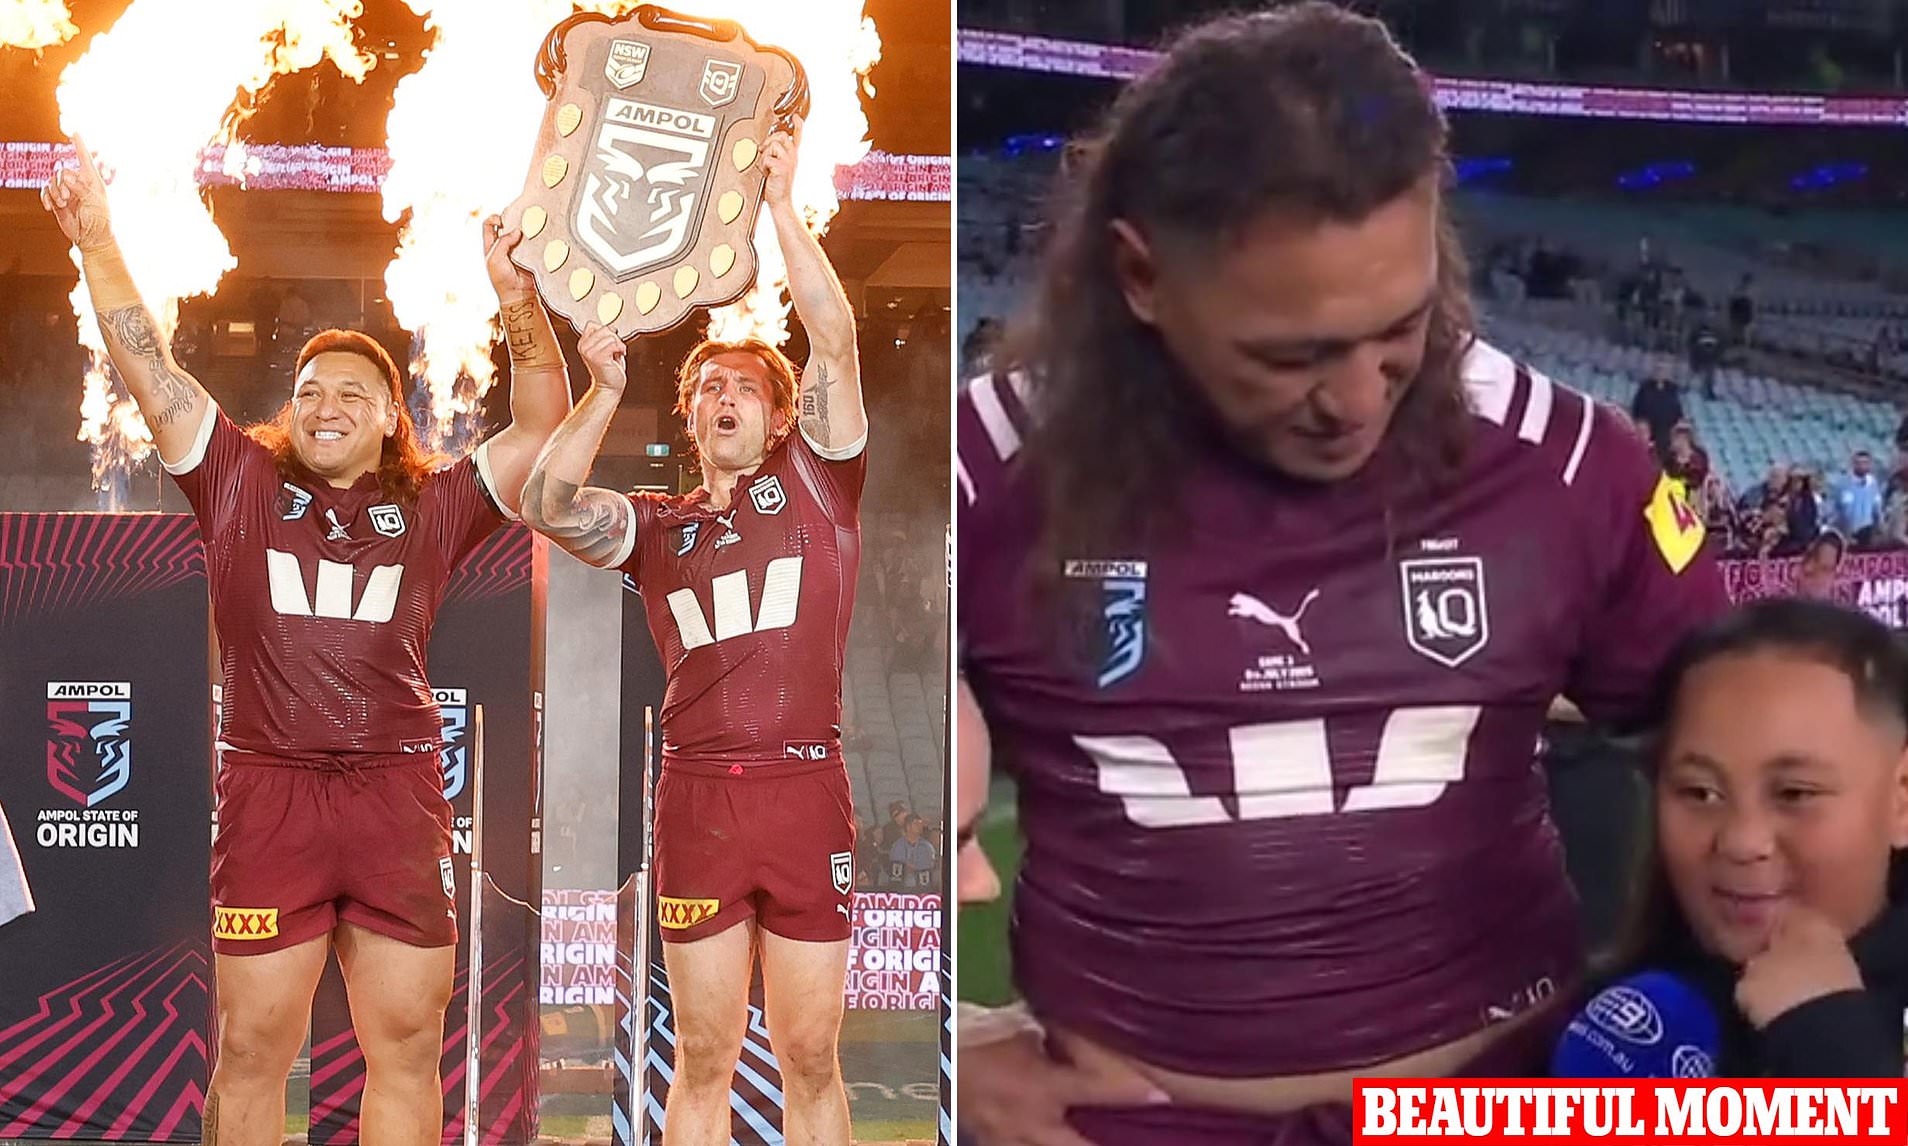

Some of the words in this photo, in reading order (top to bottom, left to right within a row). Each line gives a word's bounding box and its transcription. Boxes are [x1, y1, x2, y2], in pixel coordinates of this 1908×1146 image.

[613, 43, 646, 59] NSW
[615, 105, 705, 133] AMPOL
[1070, 563, 1142, 576] AMPOL
[1857, 579, 1908, 606] AMP
[54, 685, 124, 696] AMPOL
[432, 691, 461, 703] OL
[37, 810, 80, 821] AMPOL
[83, 810, 120, 821] STATE
[122, 810, 139, 821] OF
[456, 817, 472, 828] OF
[36, 823, 139, 848] ORIGIN
[216, 911, 272, 934] XXXX
[661, 902, 712, 924] XXXX
[863, 910, 941, 928] ORIGI
[571, 920, 617, 943] AM
[852, 928, 911, 950] IGIN
[919, 927, 941, 950] A
[540, 943, 616, 965] RIGIN
[863, 949, 941, 971] ORIGI
[570, 964, 617, 987] AM
[919, 971, 940, 993] A
[540, 986, 615, 1005] RIGIN
